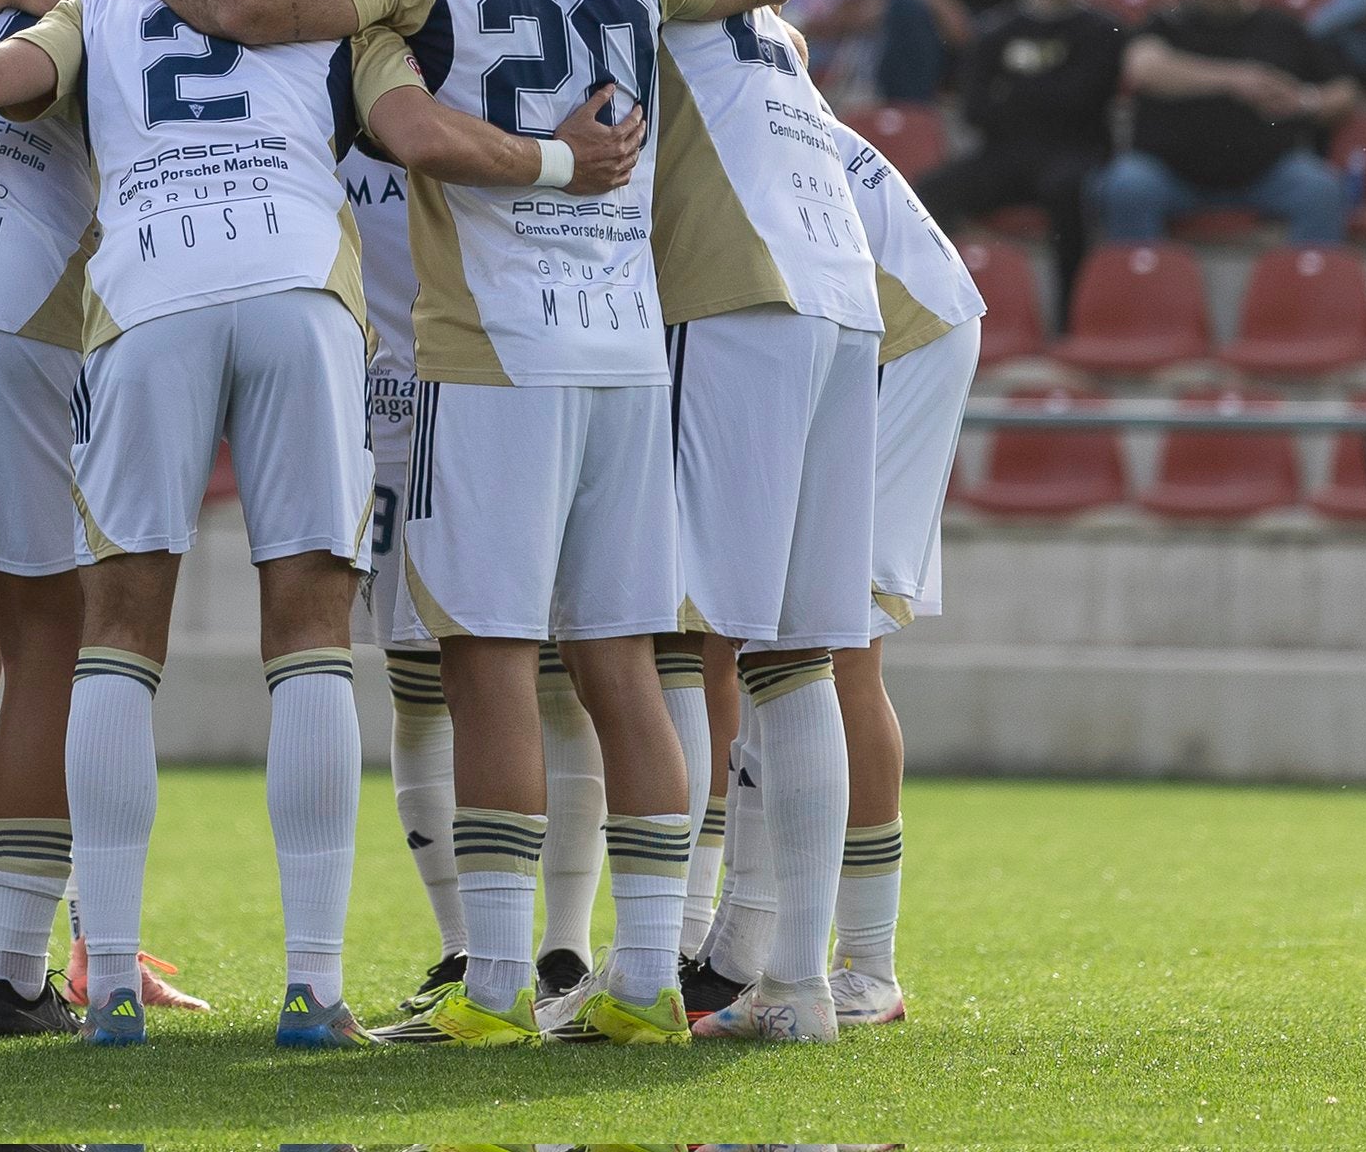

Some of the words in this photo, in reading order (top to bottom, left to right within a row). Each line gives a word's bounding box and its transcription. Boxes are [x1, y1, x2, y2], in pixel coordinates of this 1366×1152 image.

[141, 6, 251, 130] 2
[769, 120, 800, 141] Centro
[118, 179, 159, 206] Centro
[160, 163, 221, 185] Porsche
[223, 155, 289, 173] Marbella
[119, 136, 287, 189] PORSCHE
[139, 177, 269, 212] GRUPO
[512, 201, 642, 220] PORSCHE
[138, 201, 279, 262] MOSH
[515, 220, 560, 236] Centro
[538, 259, 630, 280] GRUPO
[541, 288, 649, 330] MOSH
